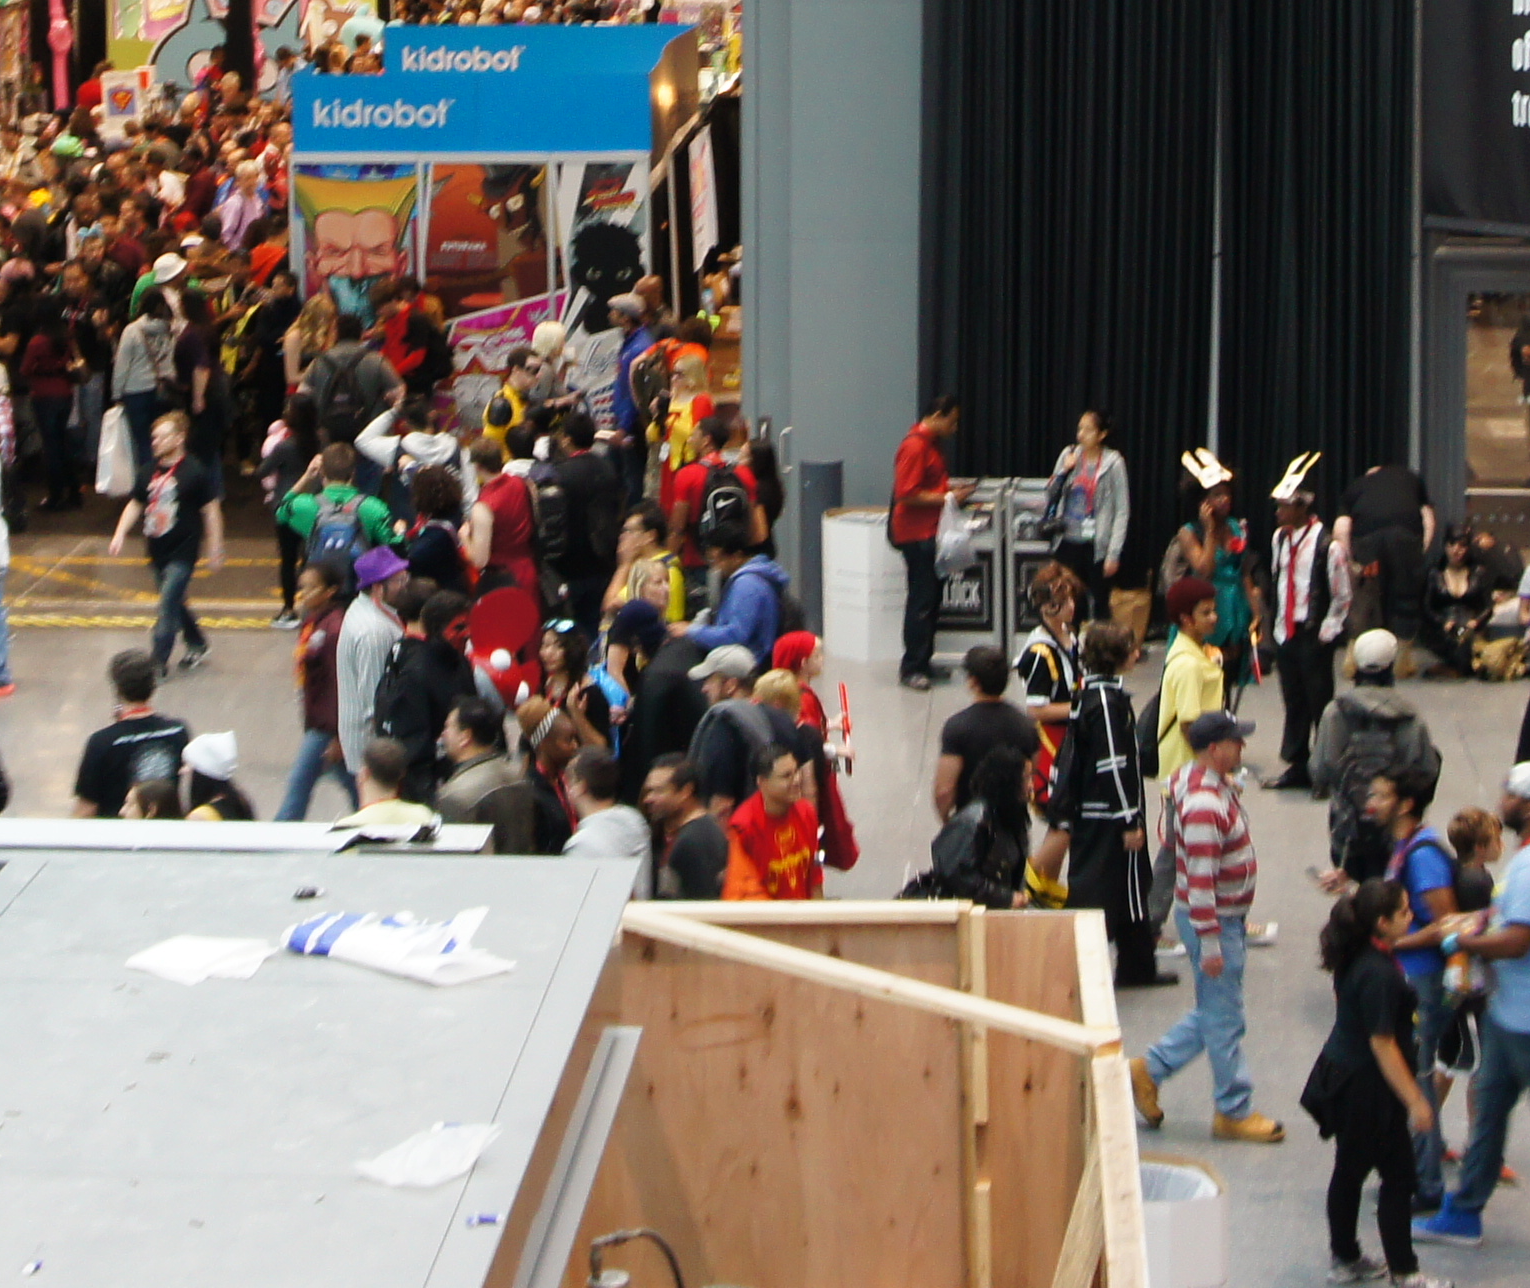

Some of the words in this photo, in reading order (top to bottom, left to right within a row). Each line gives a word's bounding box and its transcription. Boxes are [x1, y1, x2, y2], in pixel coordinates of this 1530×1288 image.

[401, 44, 522, 73] kidrobot
[312, 97, 451, 129] kidrobot
[942, 579, 982, 608] LOCK
